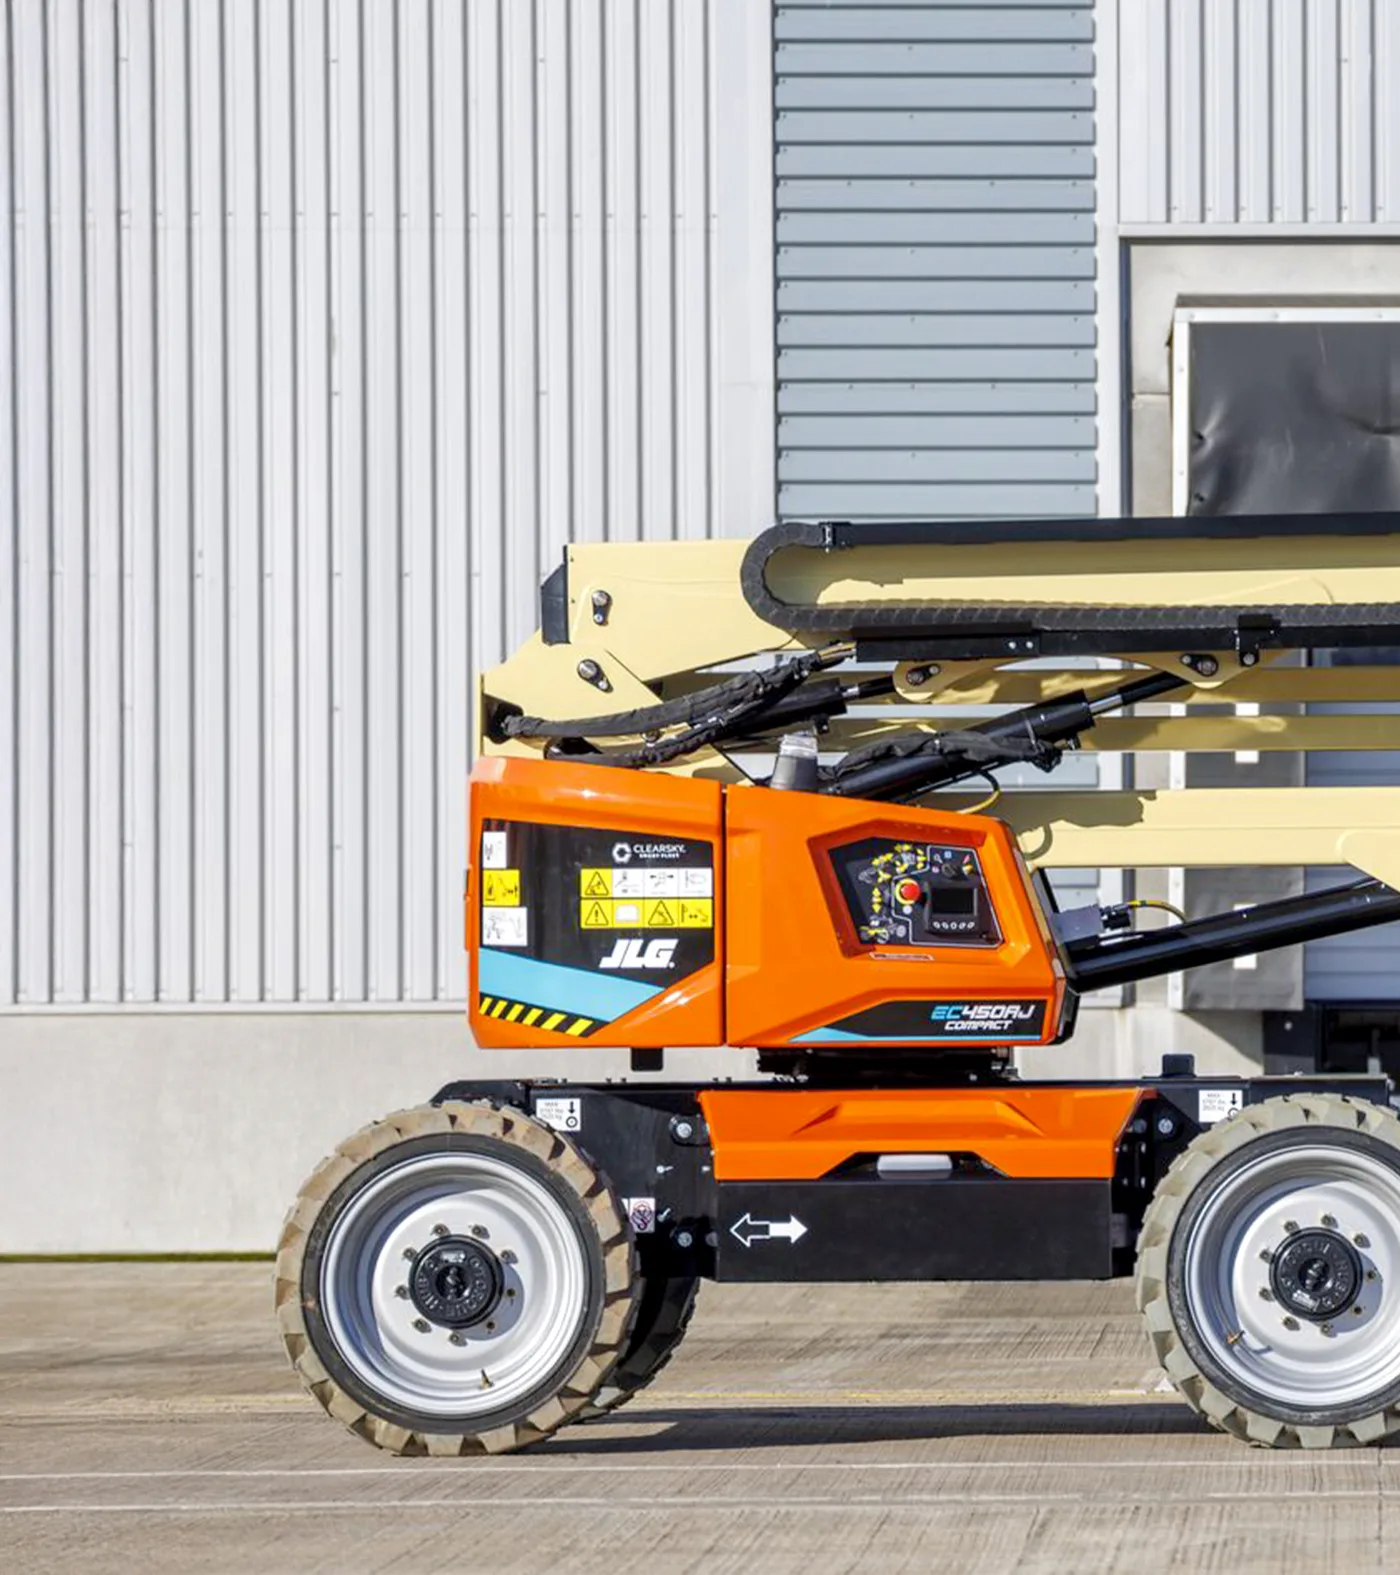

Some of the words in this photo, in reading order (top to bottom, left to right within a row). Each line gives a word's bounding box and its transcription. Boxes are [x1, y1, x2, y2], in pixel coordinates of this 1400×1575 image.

[599, 938, 679, 969] JLG
[931, 1004, 1036, 1020] EC450AJ
[944, 1020, 1014, 1031] COMPACT
